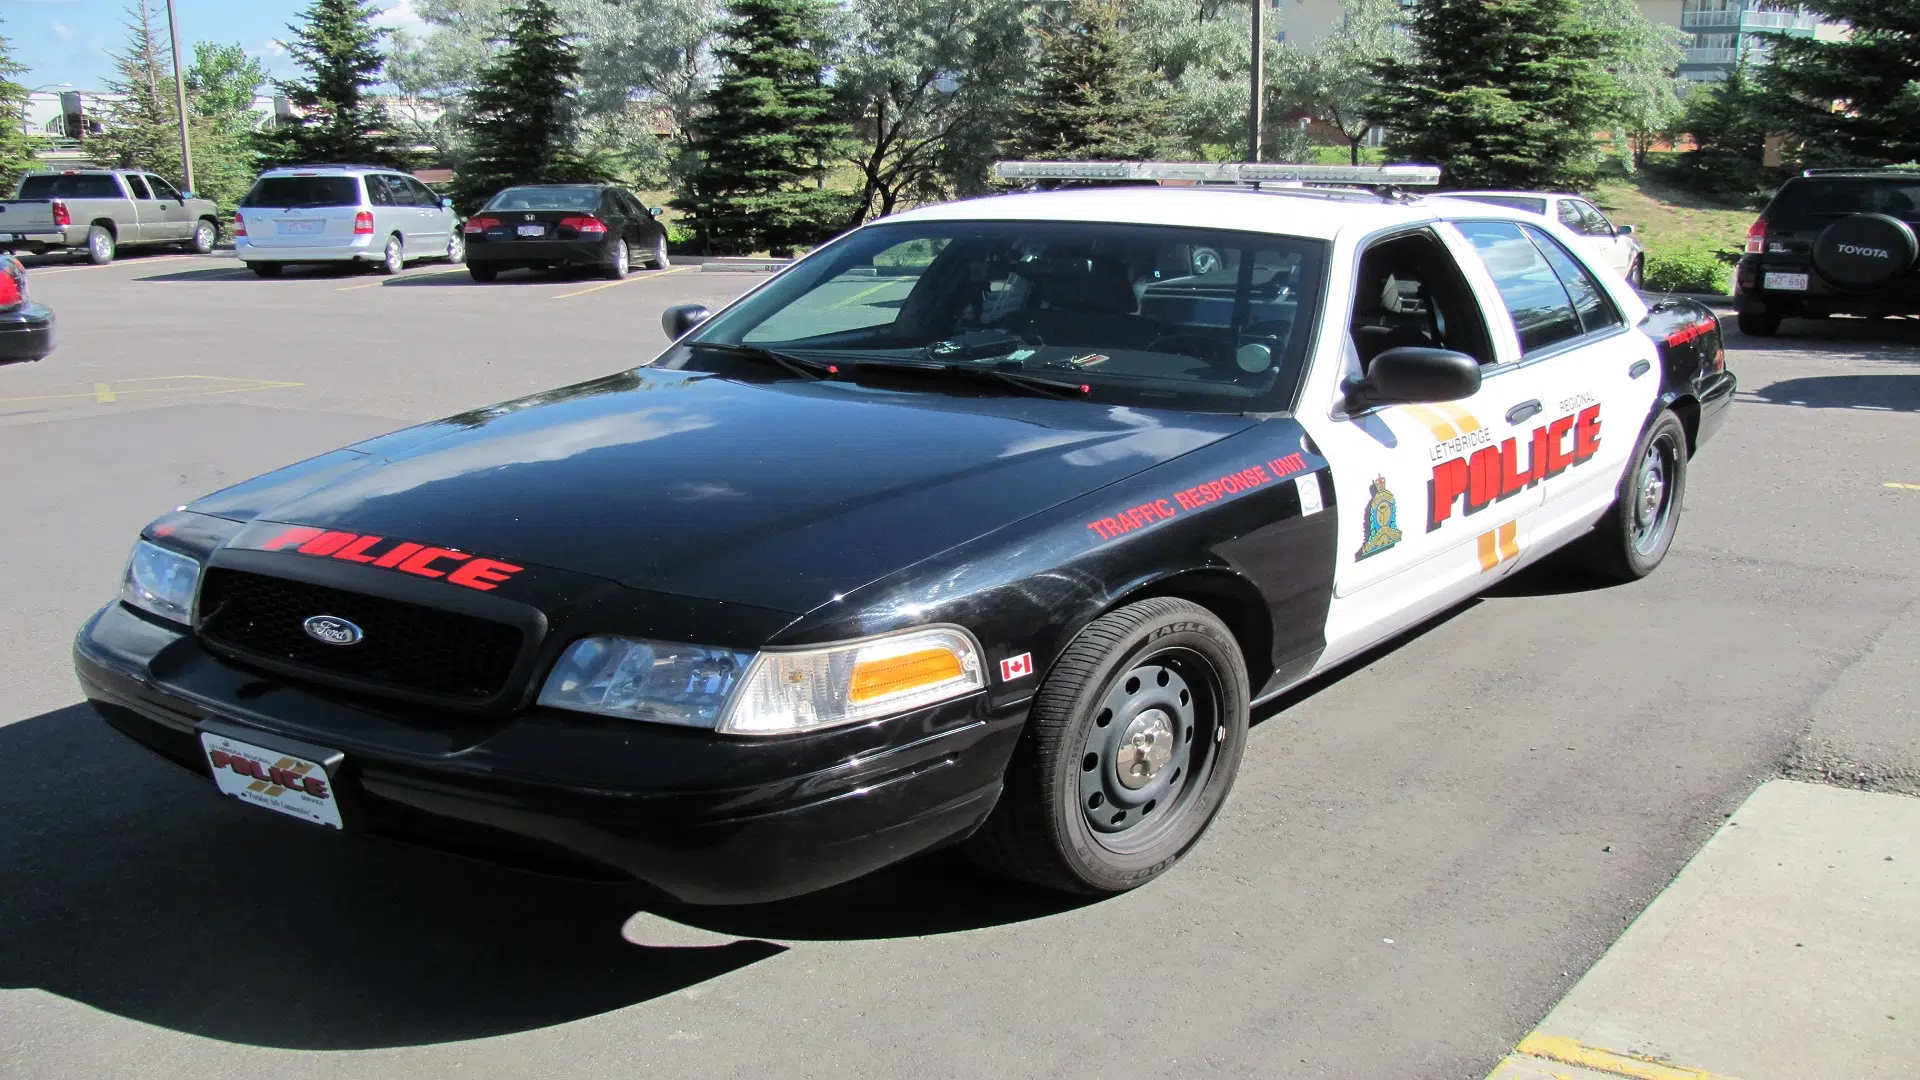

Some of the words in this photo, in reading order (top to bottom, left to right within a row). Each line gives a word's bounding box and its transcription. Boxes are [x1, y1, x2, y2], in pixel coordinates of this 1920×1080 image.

[1837, 244, 1889, 259] TOYOTA
[1429, 428, 1491, 461] LETHBRIDGE
[1559, 390, 1595, 412] REGIONAL
[1087, 498, 1176, 541] TRAFFIC
[1173, 465, 1272, 511] RESPONSE
[1267, 452, 1308, 478] UNIT
[1426, 402, 1602, 534] POLICE
[264, 527, 525, 591] POLICE
[1147, 622, 1209, 644] EAGLE
[209, 749, 330, 799] POLICE
